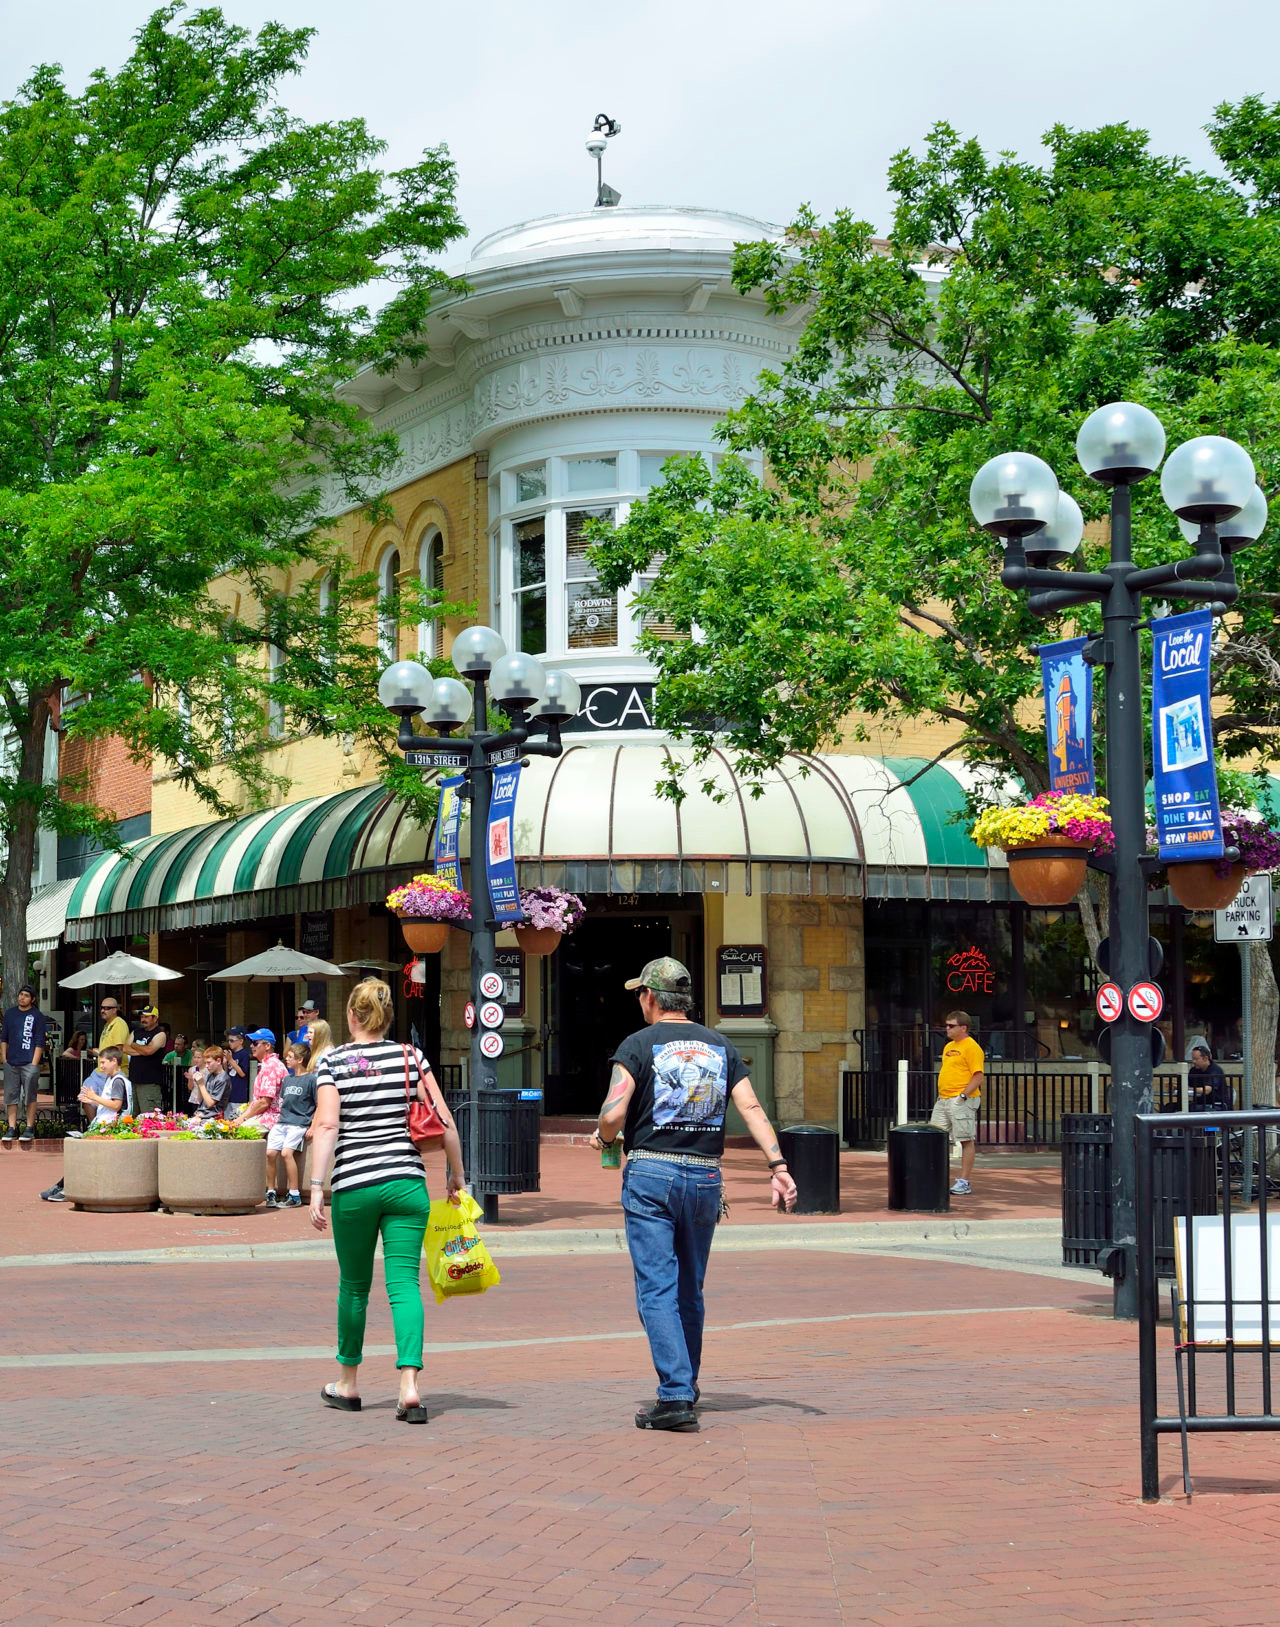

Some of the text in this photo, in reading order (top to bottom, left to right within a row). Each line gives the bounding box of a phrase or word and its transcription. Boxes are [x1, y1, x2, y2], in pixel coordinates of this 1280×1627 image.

[574, 598, 612, 608] RODWIN
[1169, 629, 1194, 646] Love the
[1161, 633, 1203, 671] Local
[585, 686, 692, 728] CA
[414, 754, 461, 766] 13th STREET
[490, 747, 517, 763] PEARL STREET
[1054, 771, 1090, 789] UNIVERSITY
[494, 777, 517, 800] Local
[1161, 789, 1210, 805] SHOP EAT
[1163, 809, 1212, 825] DINE PLAY
[1165, 829, 1215, 845] STAY ENJOY
[1240, 881, 1250, 894] O
[618, 895, 640, 905] 1247
[1225, 910, 1261, 922] PARKING
[499, 955, 520, 964] CAFE
[740, 952, 763, 962] CAFE
[946, 945, 990, 967] Boulder
[946, 971, 993, 992] CAFE
